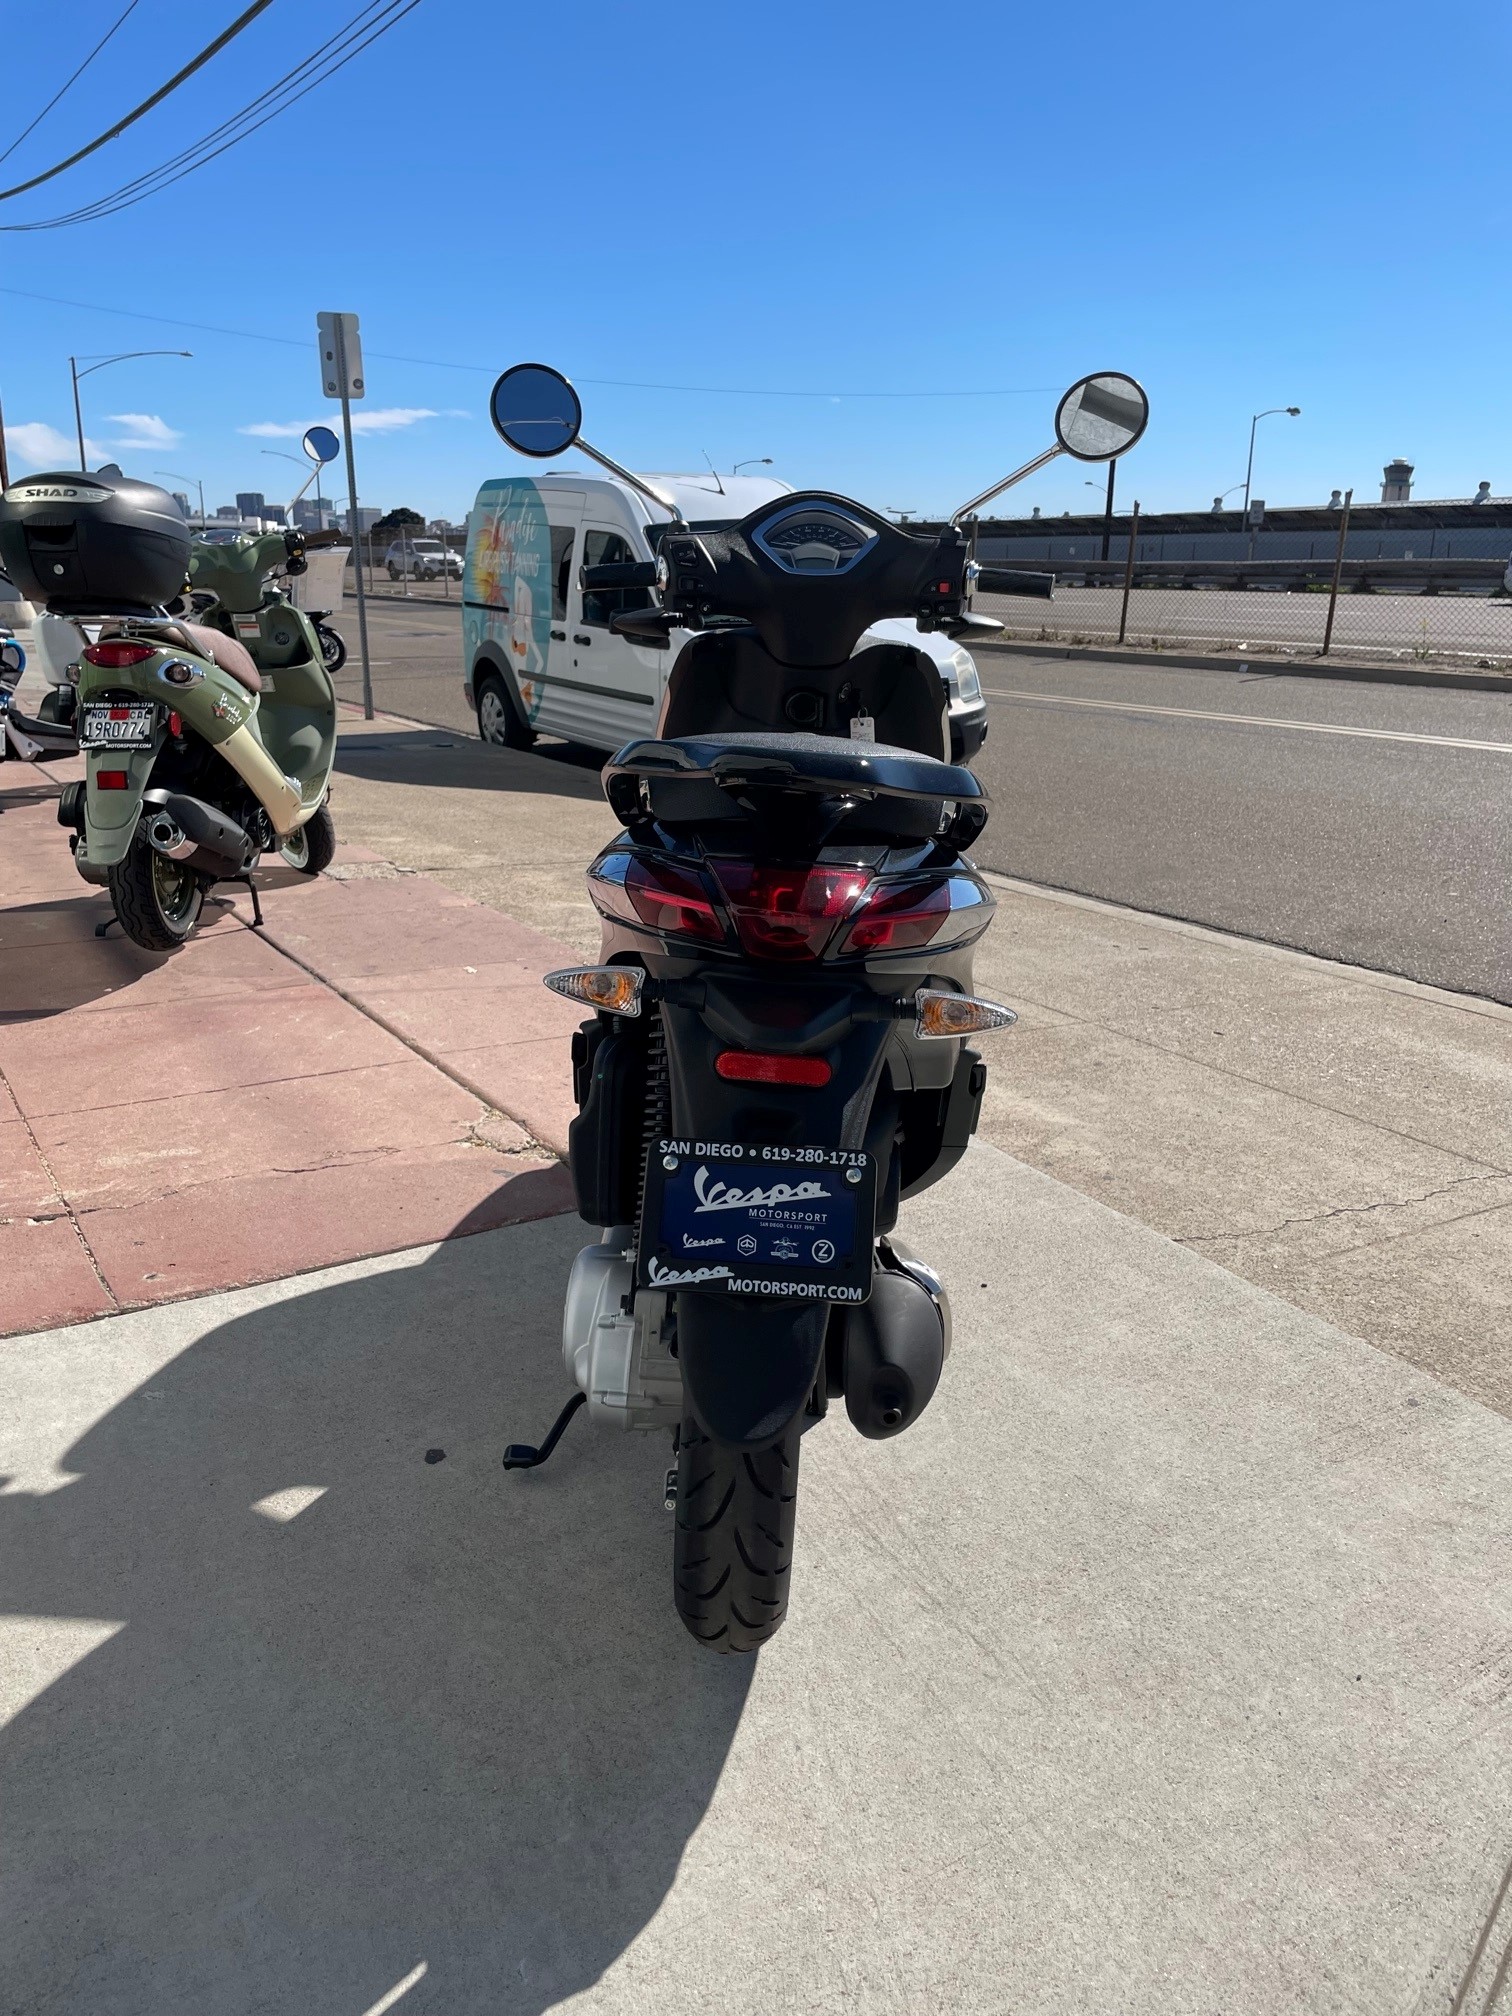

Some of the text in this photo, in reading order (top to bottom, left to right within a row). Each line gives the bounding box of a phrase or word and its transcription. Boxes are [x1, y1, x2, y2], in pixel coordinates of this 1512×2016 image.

[25, 488, 78, 498] SHAD
[92, 711, 109, 719] NOV
[130, 711, 149, 719] CAL
[659, 1140, 867, 1167] SAN DIEGO 619-280-1718
[693, 1165, 832, 1213] Vespa
[748, 1208, 828, 1222] MOTORSPORT
[682, 1233, 726, 1248] Vespa
[648, 1256, 735, 1287] Vespa
[728, 1278, 862, 1300] MOTORSPORT.COM
